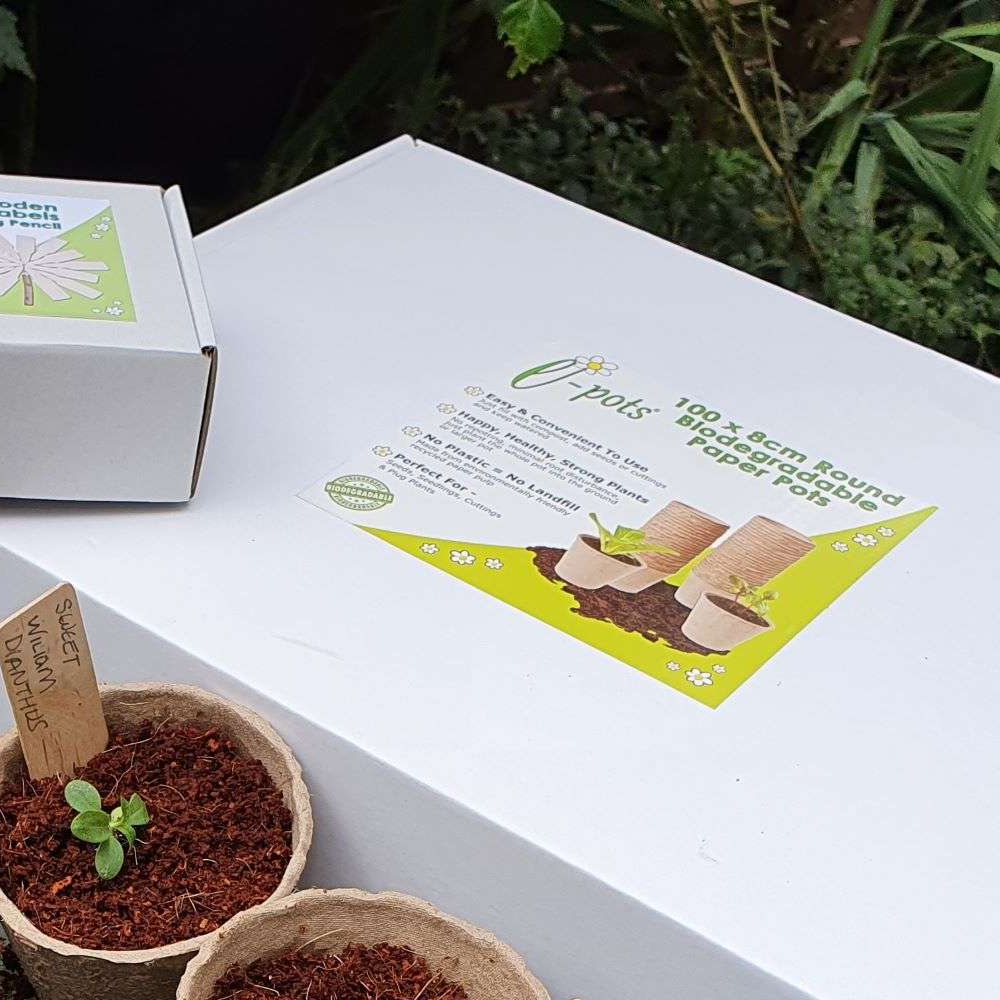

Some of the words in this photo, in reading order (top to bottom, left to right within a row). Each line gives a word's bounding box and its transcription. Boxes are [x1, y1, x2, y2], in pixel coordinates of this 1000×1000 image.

[9, 219, 62, 230] Pencil
[440, 450, 463, 464] from
[457, 410, 500, 435] Happy,
[504, 432, 556, 461] Healthy,
[559, 459, 605, 484] Strong
[606, 481, 649, 504] Plants
[485, 393, 516, 410] Easy
[530, 414, 603, 451] Convenient
[605, 448, 621, 460] To
[623, 457, 649, 473] Use
[486, 439, 503, 450] the
[567, 478, 584, 489] the
[675, 397, 722, 423] 100
[720, 420, 744, 435] x
[746, 431, 808, 463] 8cm
[813, 460, 905, 507] Round
[676, 415, 877, 511] Biodegradable
[393, 453, 443, 480] Perfect
[443, 477, 469, 491] For
[423, 433, 443, 445] No
[444, 443, 490, 468] Plastic
[505, 473, 526, 486] No
[527, 484, 581, 512] Landfill
[686, 436, 770, 477] Paper
[772, 474, 831, 507] Pots
[56, 598, 81, 667] SWEET
[4, 637, 49, 733] DIANTHUS
